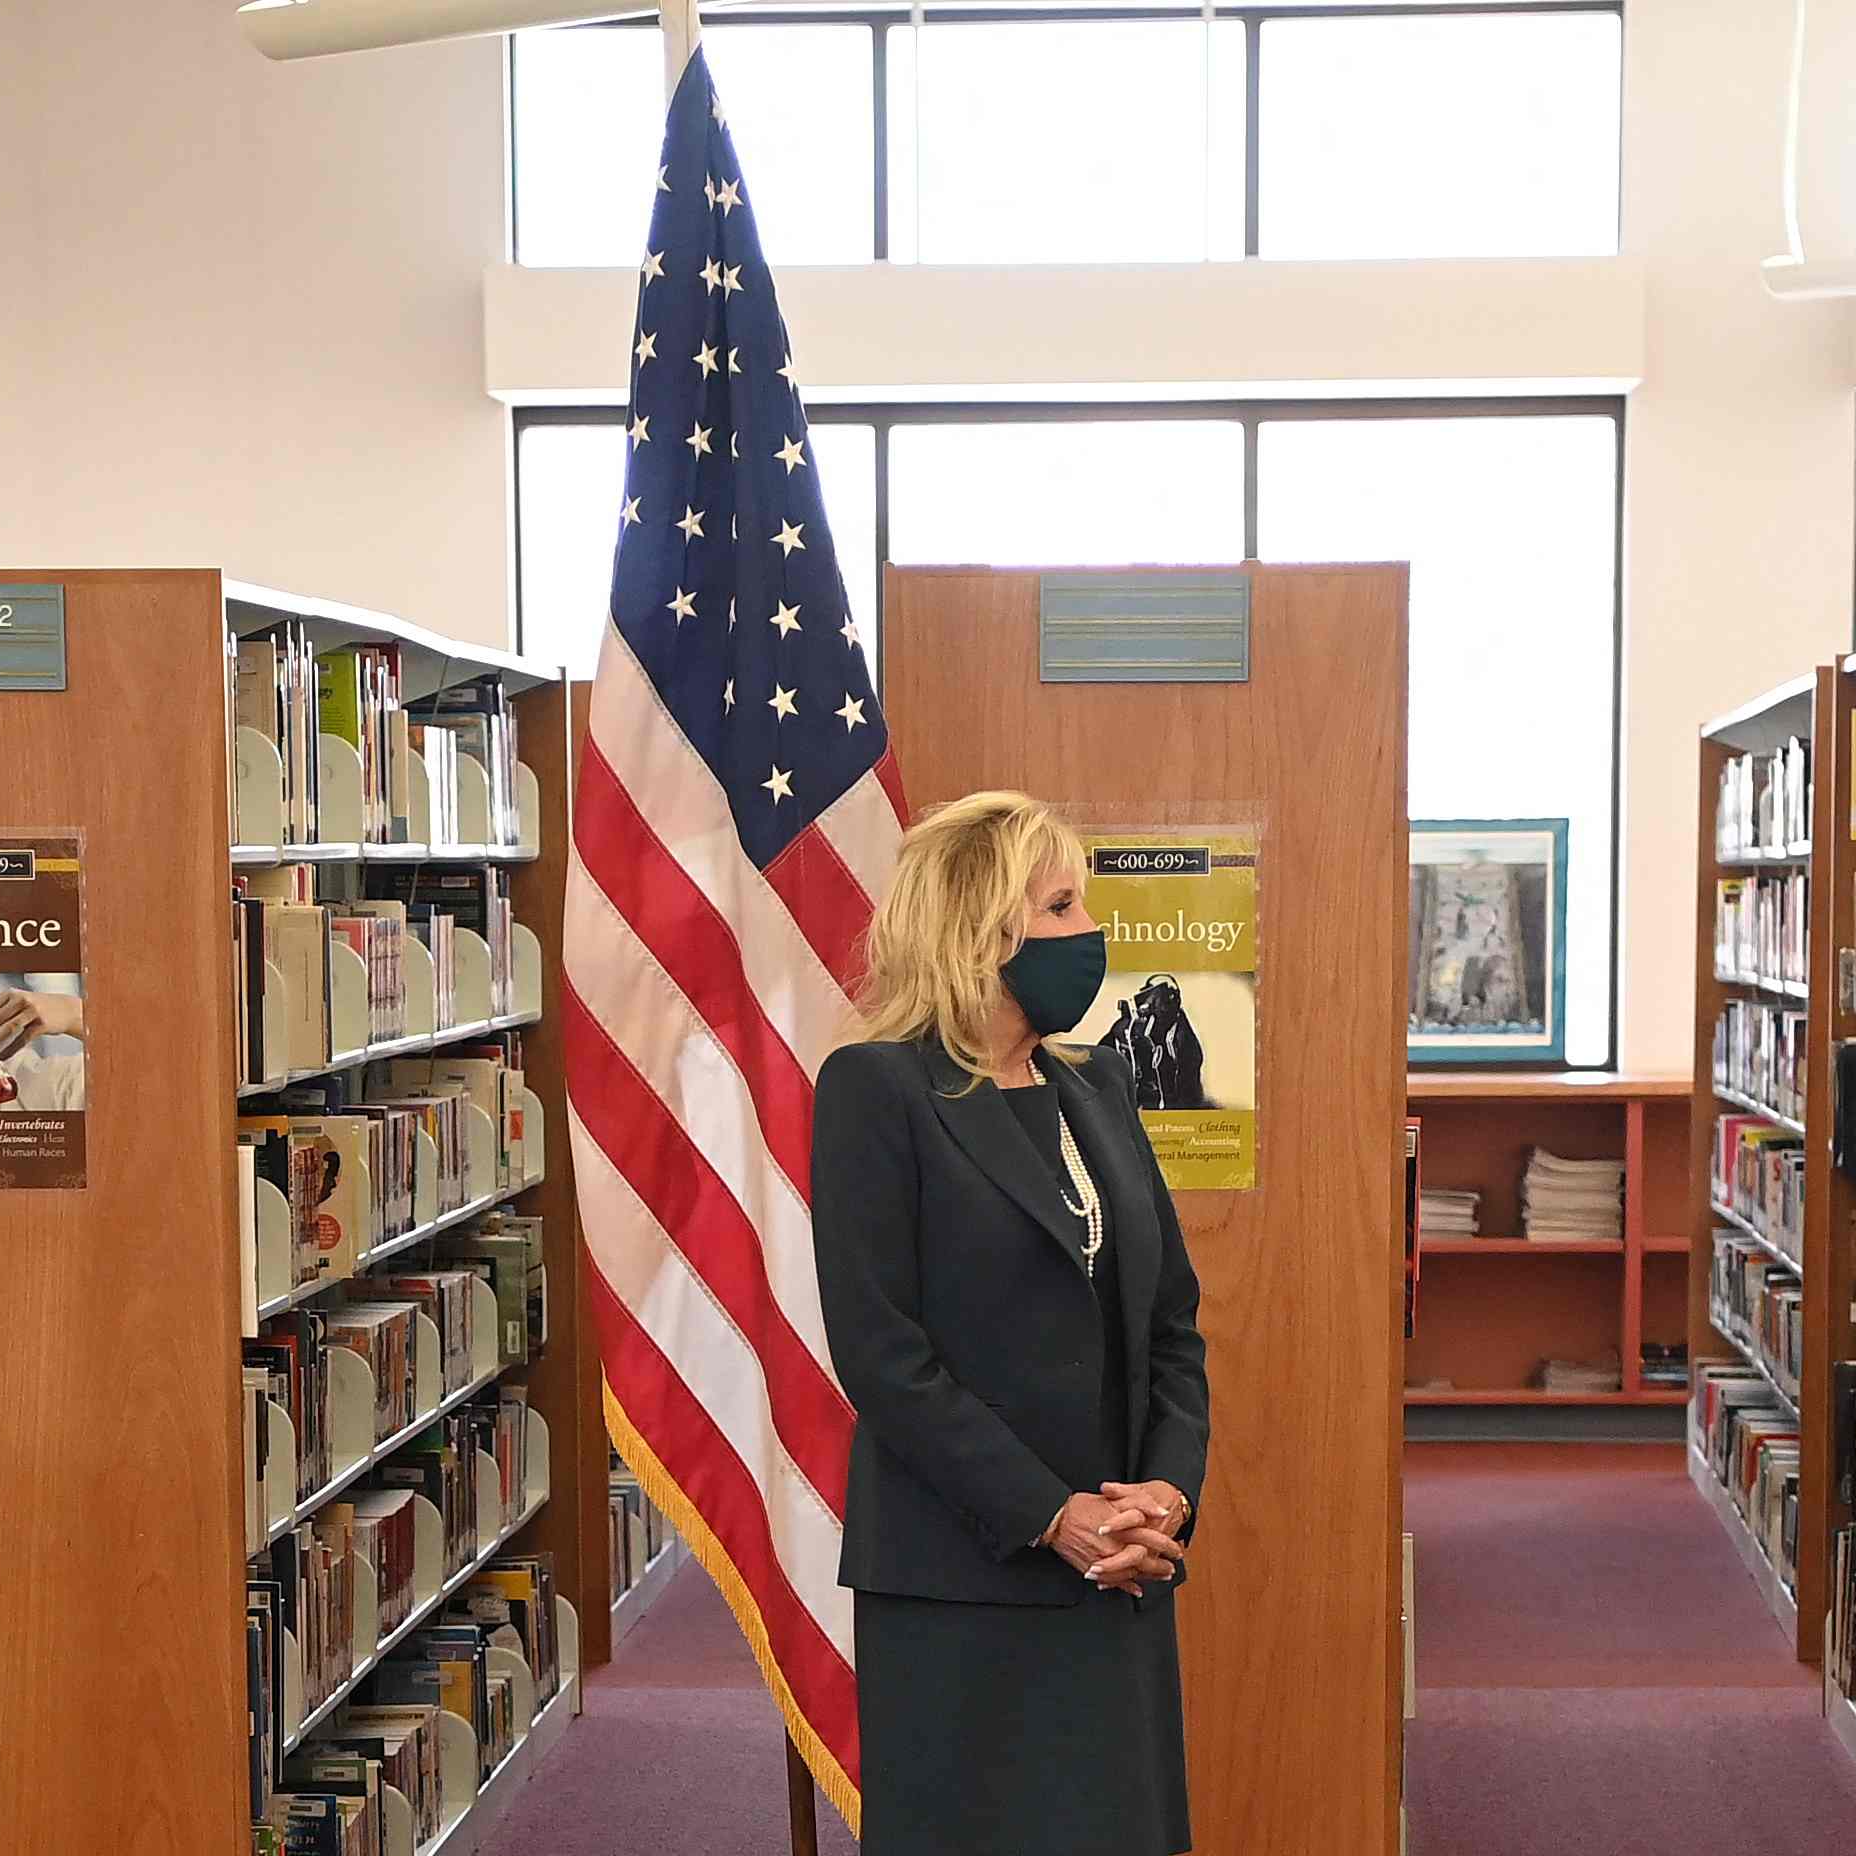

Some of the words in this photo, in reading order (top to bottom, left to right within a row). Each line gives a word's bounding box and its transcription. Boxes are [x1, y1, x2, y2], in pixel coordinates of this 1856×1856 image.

[0, 1119, 65, 1131] Invertebrates
[1189, 1136, 1241, 1149] Accounting
[2, 1147, 37, 1158] Human
[1177, 1151, 1240, 1162] Management
